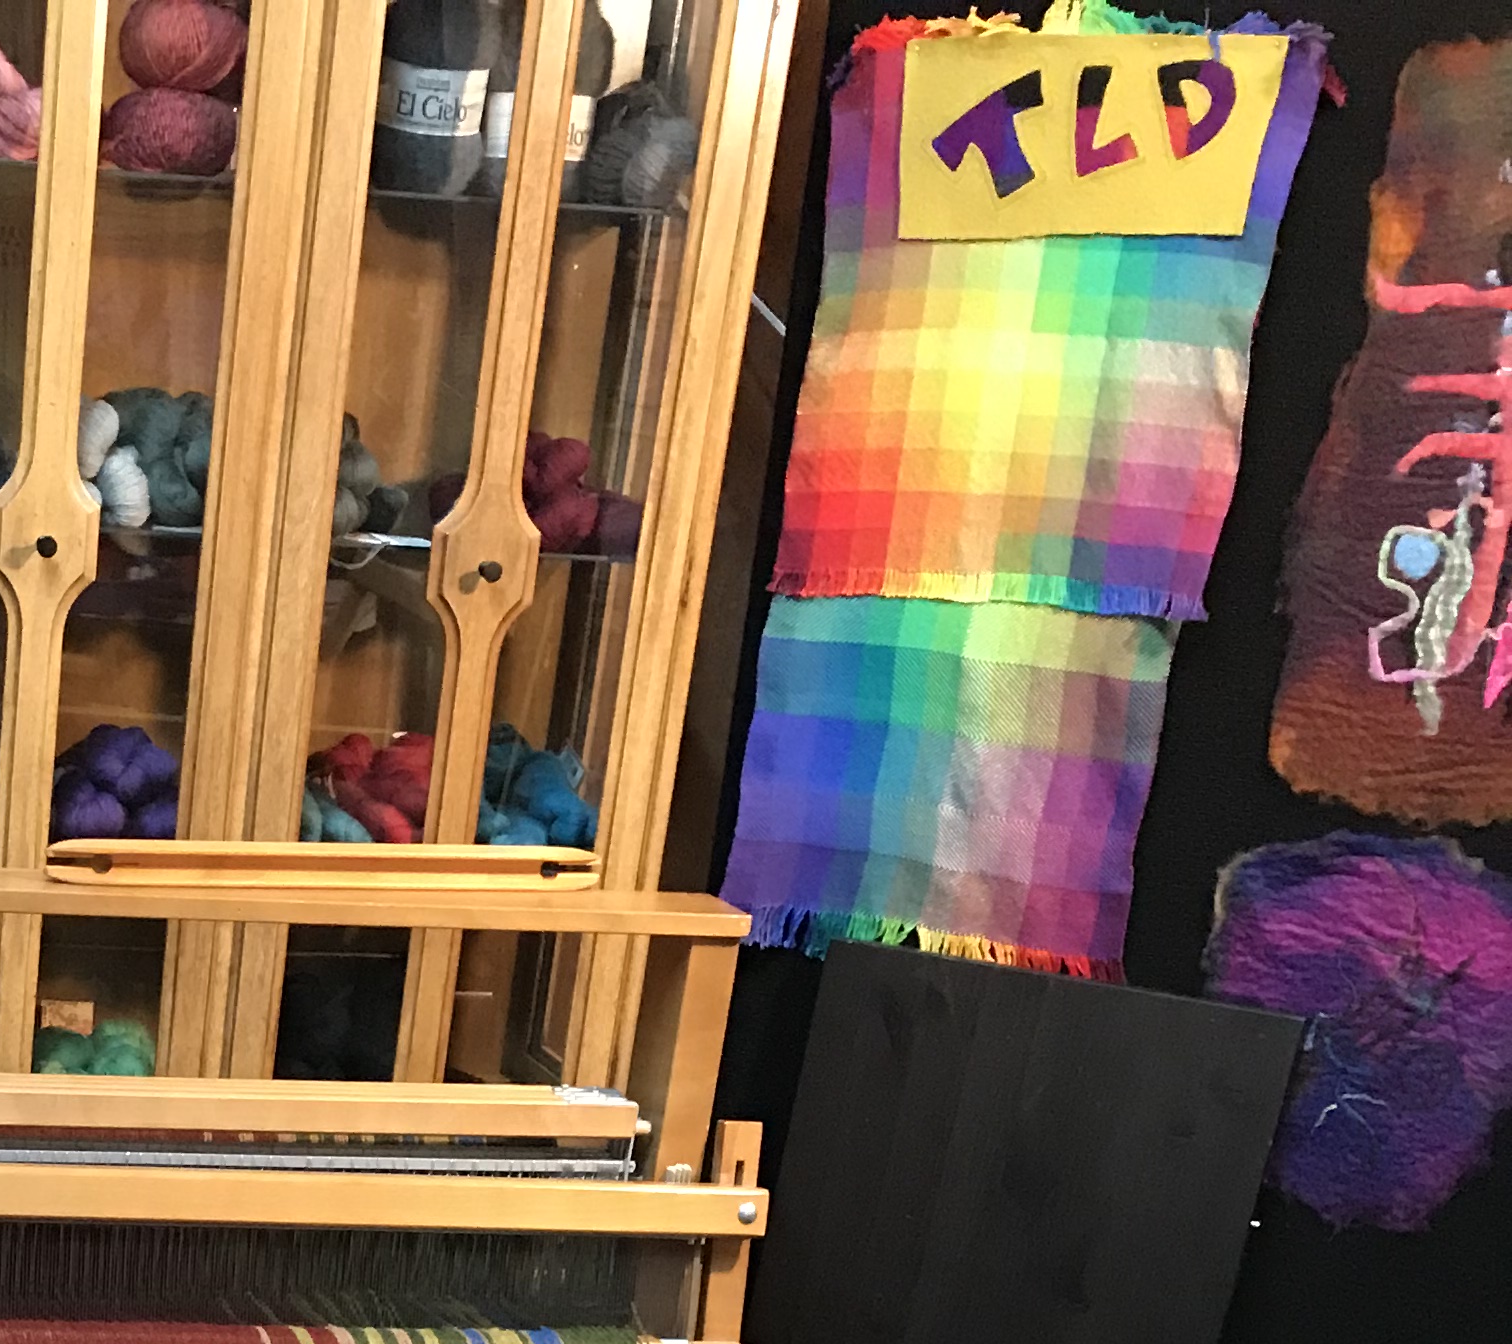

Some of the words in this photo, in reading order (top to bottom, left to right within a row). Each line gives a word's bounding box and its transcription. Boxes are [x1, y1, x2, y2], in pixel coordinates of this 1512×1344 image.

[397, 90, 417, 117] El
[422, 95, 468, 123] Cielo
[932, 59, 1237, 199] TLD
